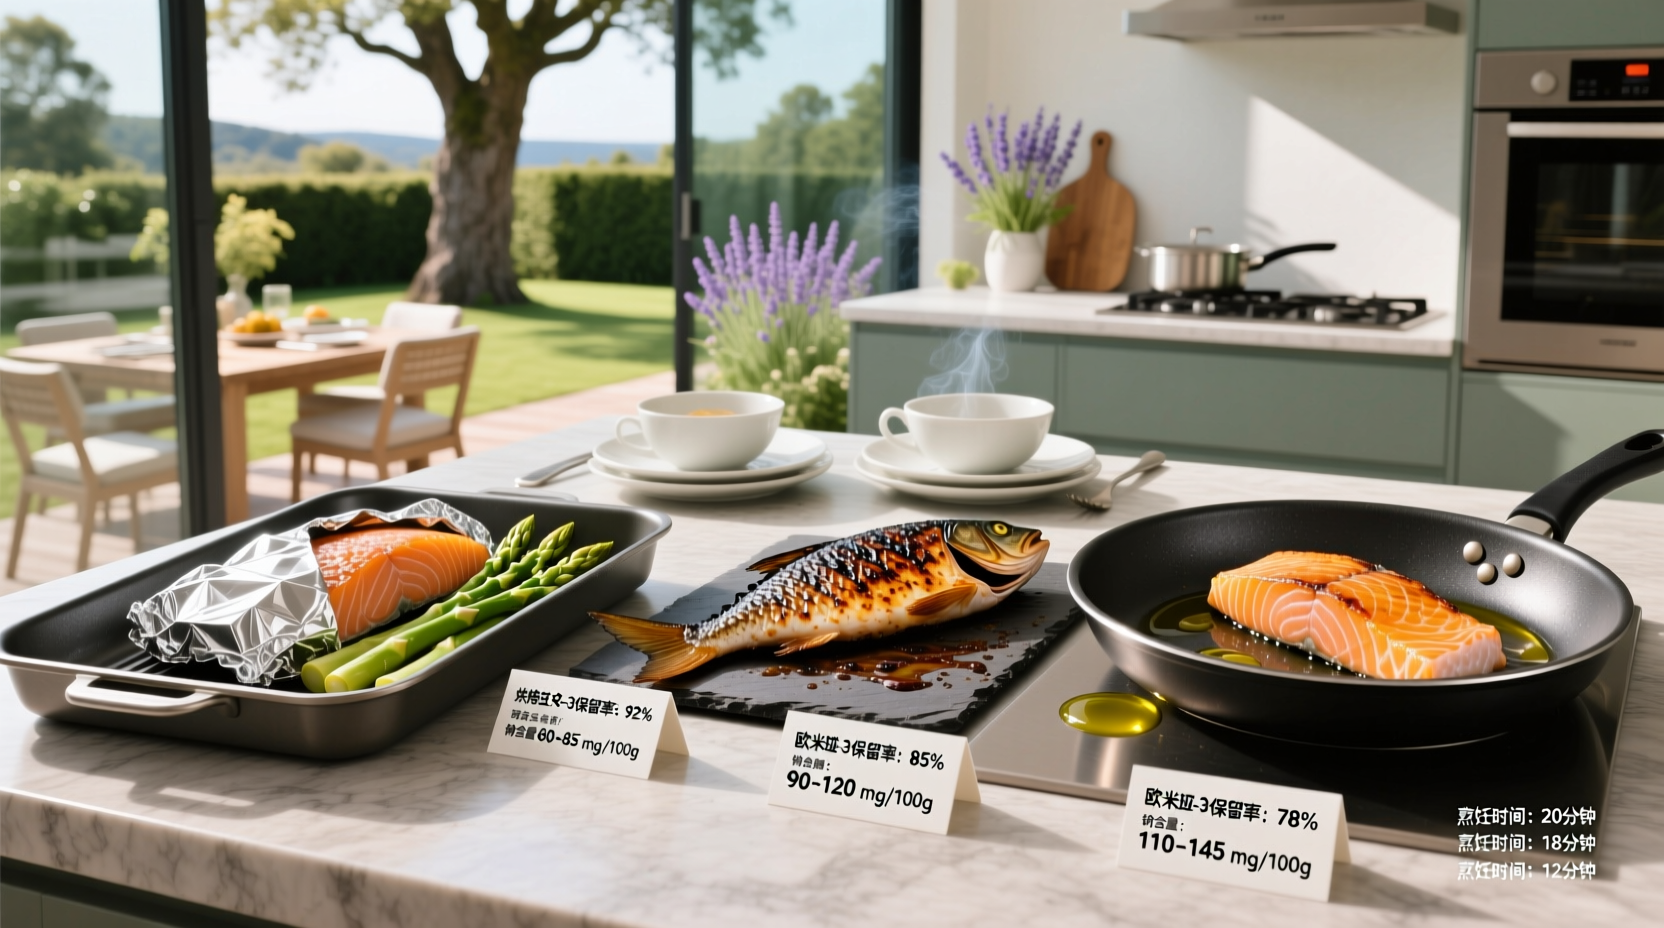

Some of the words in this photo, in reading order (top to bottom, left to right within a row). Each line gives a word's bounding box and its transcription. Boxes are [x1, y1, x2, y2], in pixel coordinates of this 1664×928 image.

[581, 739, 640, 761] mg/100g
[786, 770, 857, 797] 90-120
[859, 787, 934, 815] mg/100g
[1138, 831, 1226, 861] 110-145
[1230, 851, 1312, 880] mg/100g
